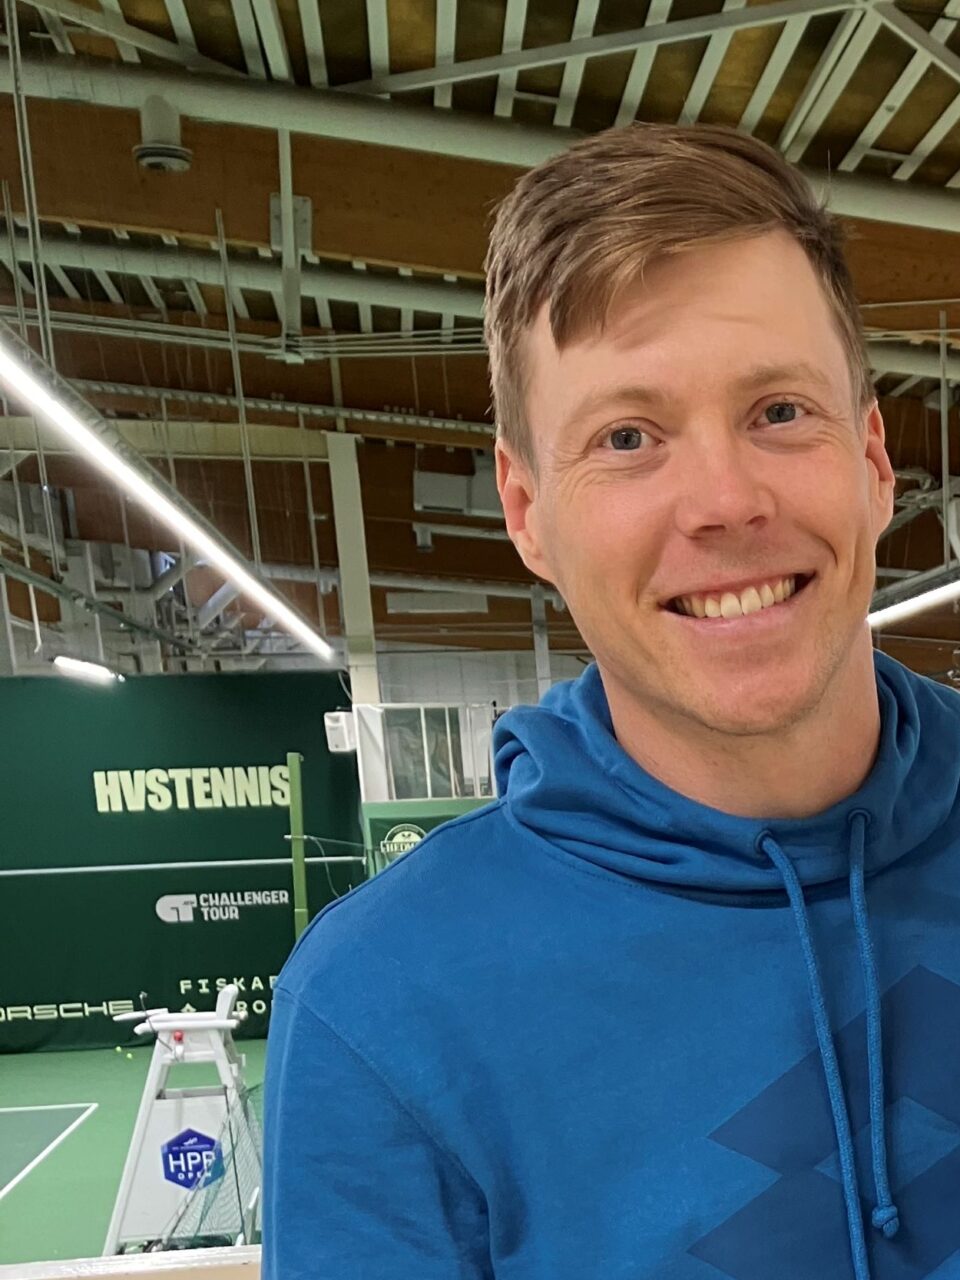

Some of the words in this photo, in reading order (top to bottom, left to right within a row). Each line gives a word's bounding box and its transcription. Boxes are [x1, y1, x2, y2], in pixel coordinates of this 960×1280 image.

[93, 765, 291, 813] HVSTENNIS
[200, 890, 289, 907] CHALLENGER
[201, 906, 240, 922] TOUR
[0, 1000, 134, 1021] RSCHE
